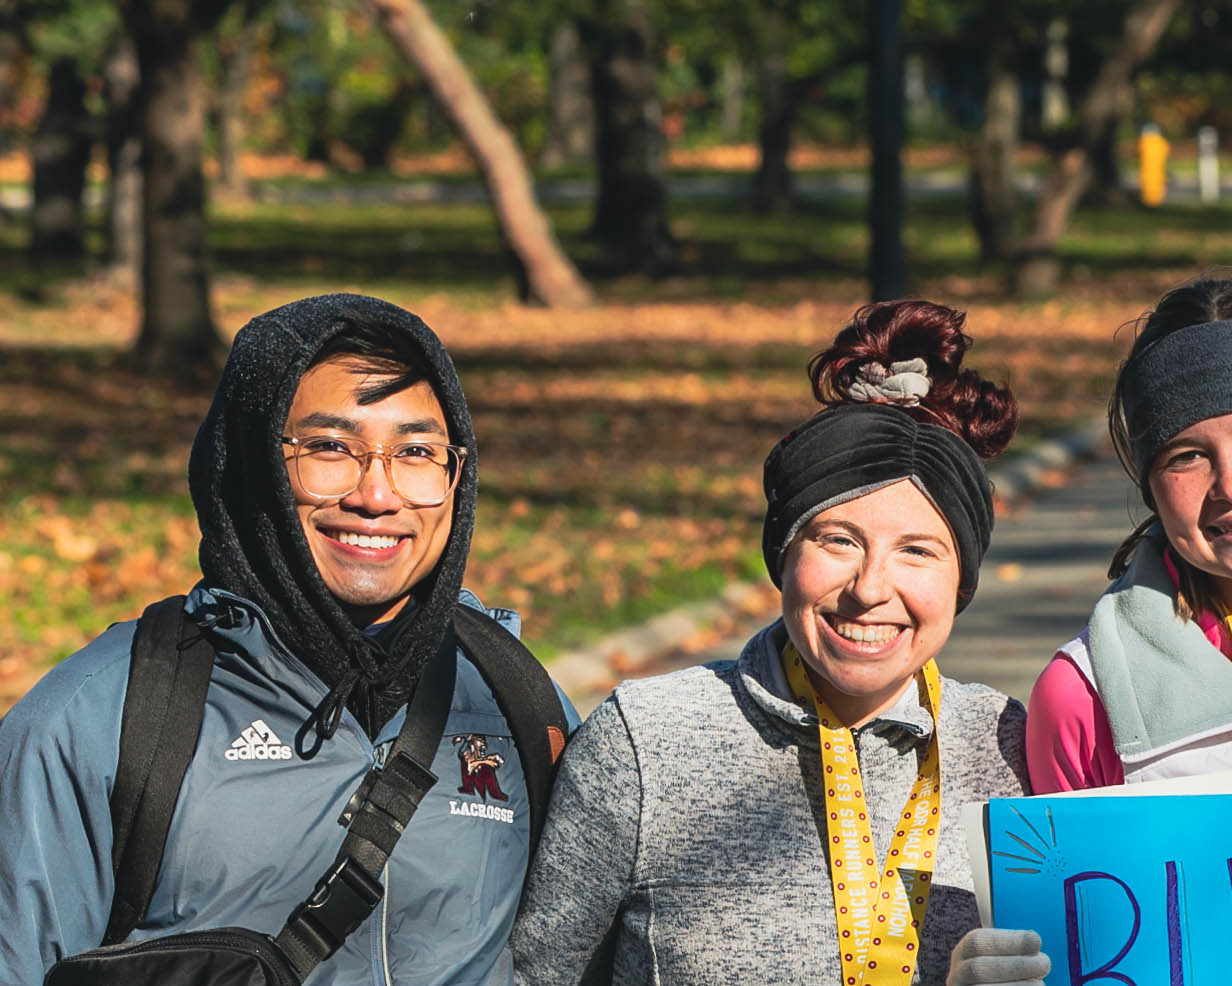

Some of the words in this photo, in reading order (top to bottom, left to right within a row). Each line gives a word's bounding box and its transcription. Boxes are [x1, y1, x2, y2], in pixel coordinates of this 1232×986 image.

[224, 742, 293, 760] adidas
[918, 774, 934, 798] THE
[448, 800, 514, 824] LACROSSE
[912, 800, 931, 826] QDR
[839, 808, 865, 882] RUNNERS
[903, 828, 924, 860] HALF
[849, 887, 871, 964] DISTANCE
